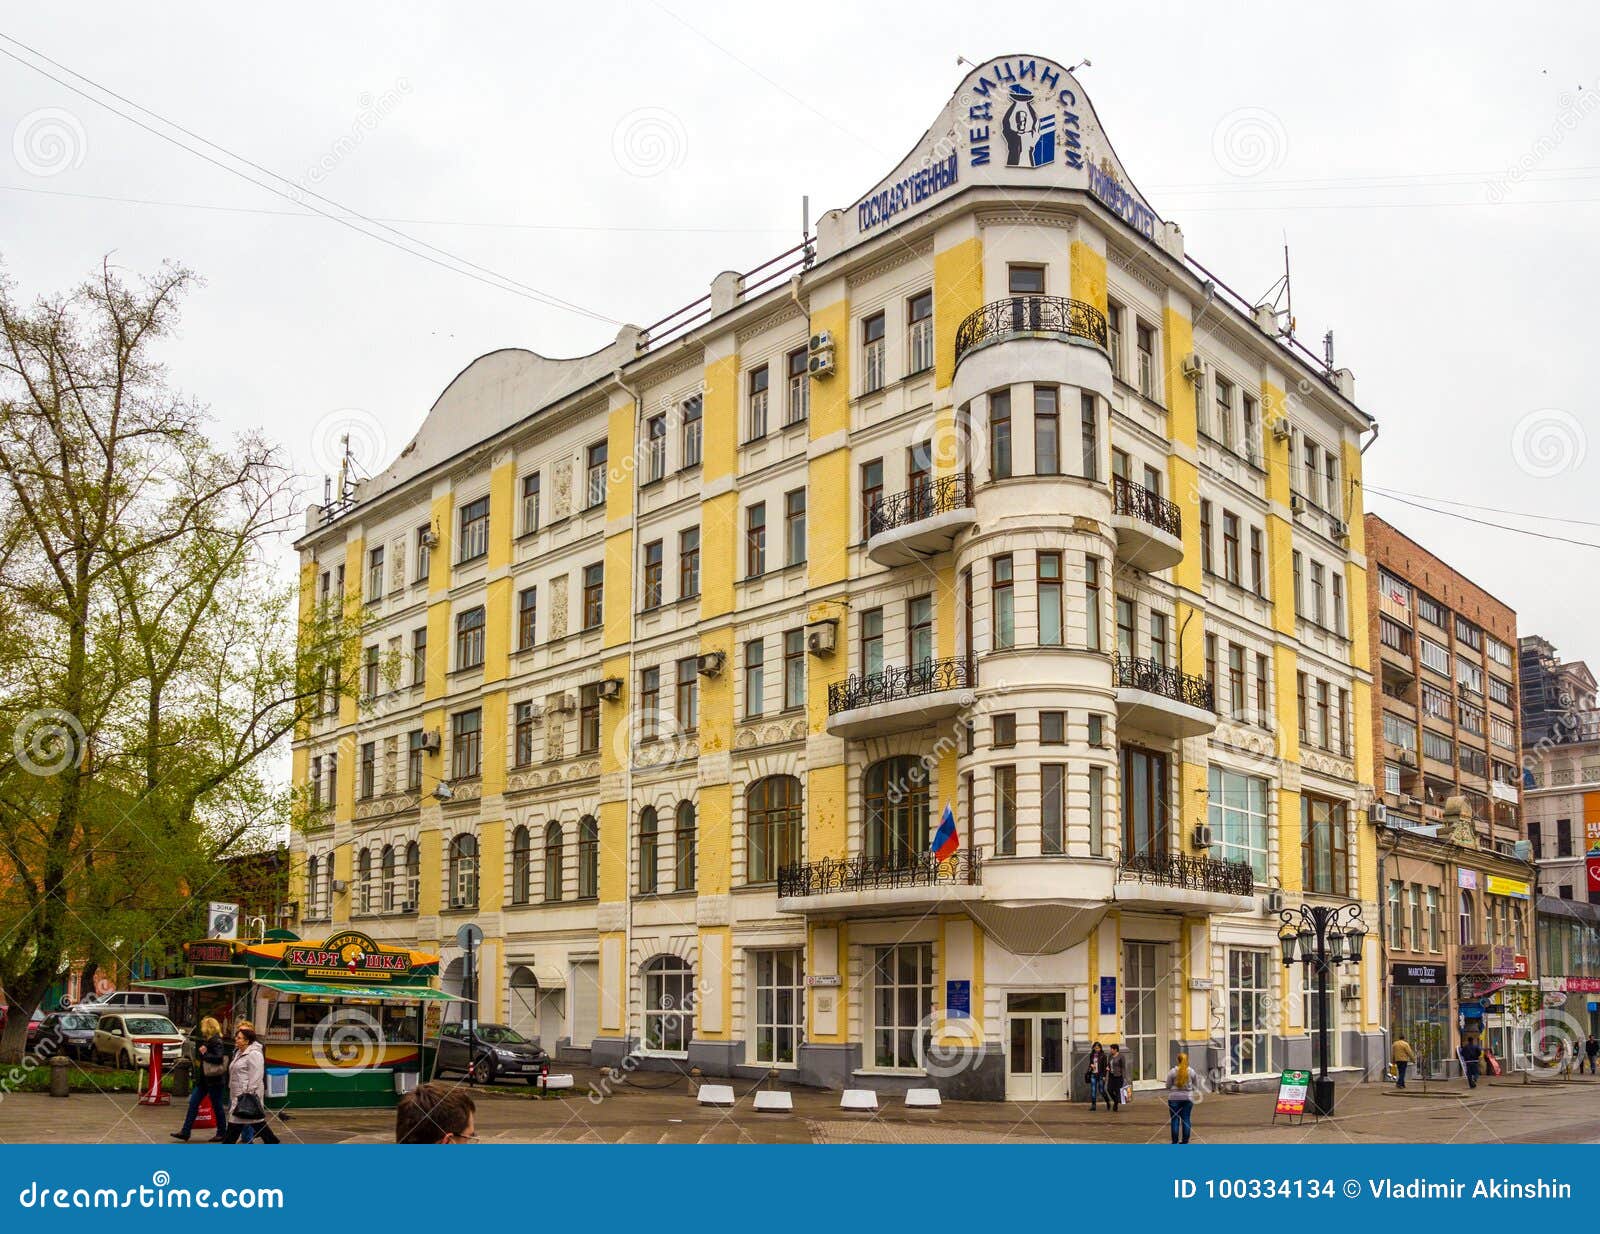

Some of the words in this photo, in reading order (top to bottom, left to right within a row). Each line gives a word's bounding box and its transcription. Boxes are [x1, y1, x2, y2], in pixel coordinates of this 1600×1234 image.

[969, 59, 1083, 171] МЕДИЦИНСКИЙ
[858, 146, 959, 233] ГОСУДАРСТВЕННЫЙ
[333, 936, 370, 950] КРОШКА
[1407, 967, 1423, 976] MARCO
